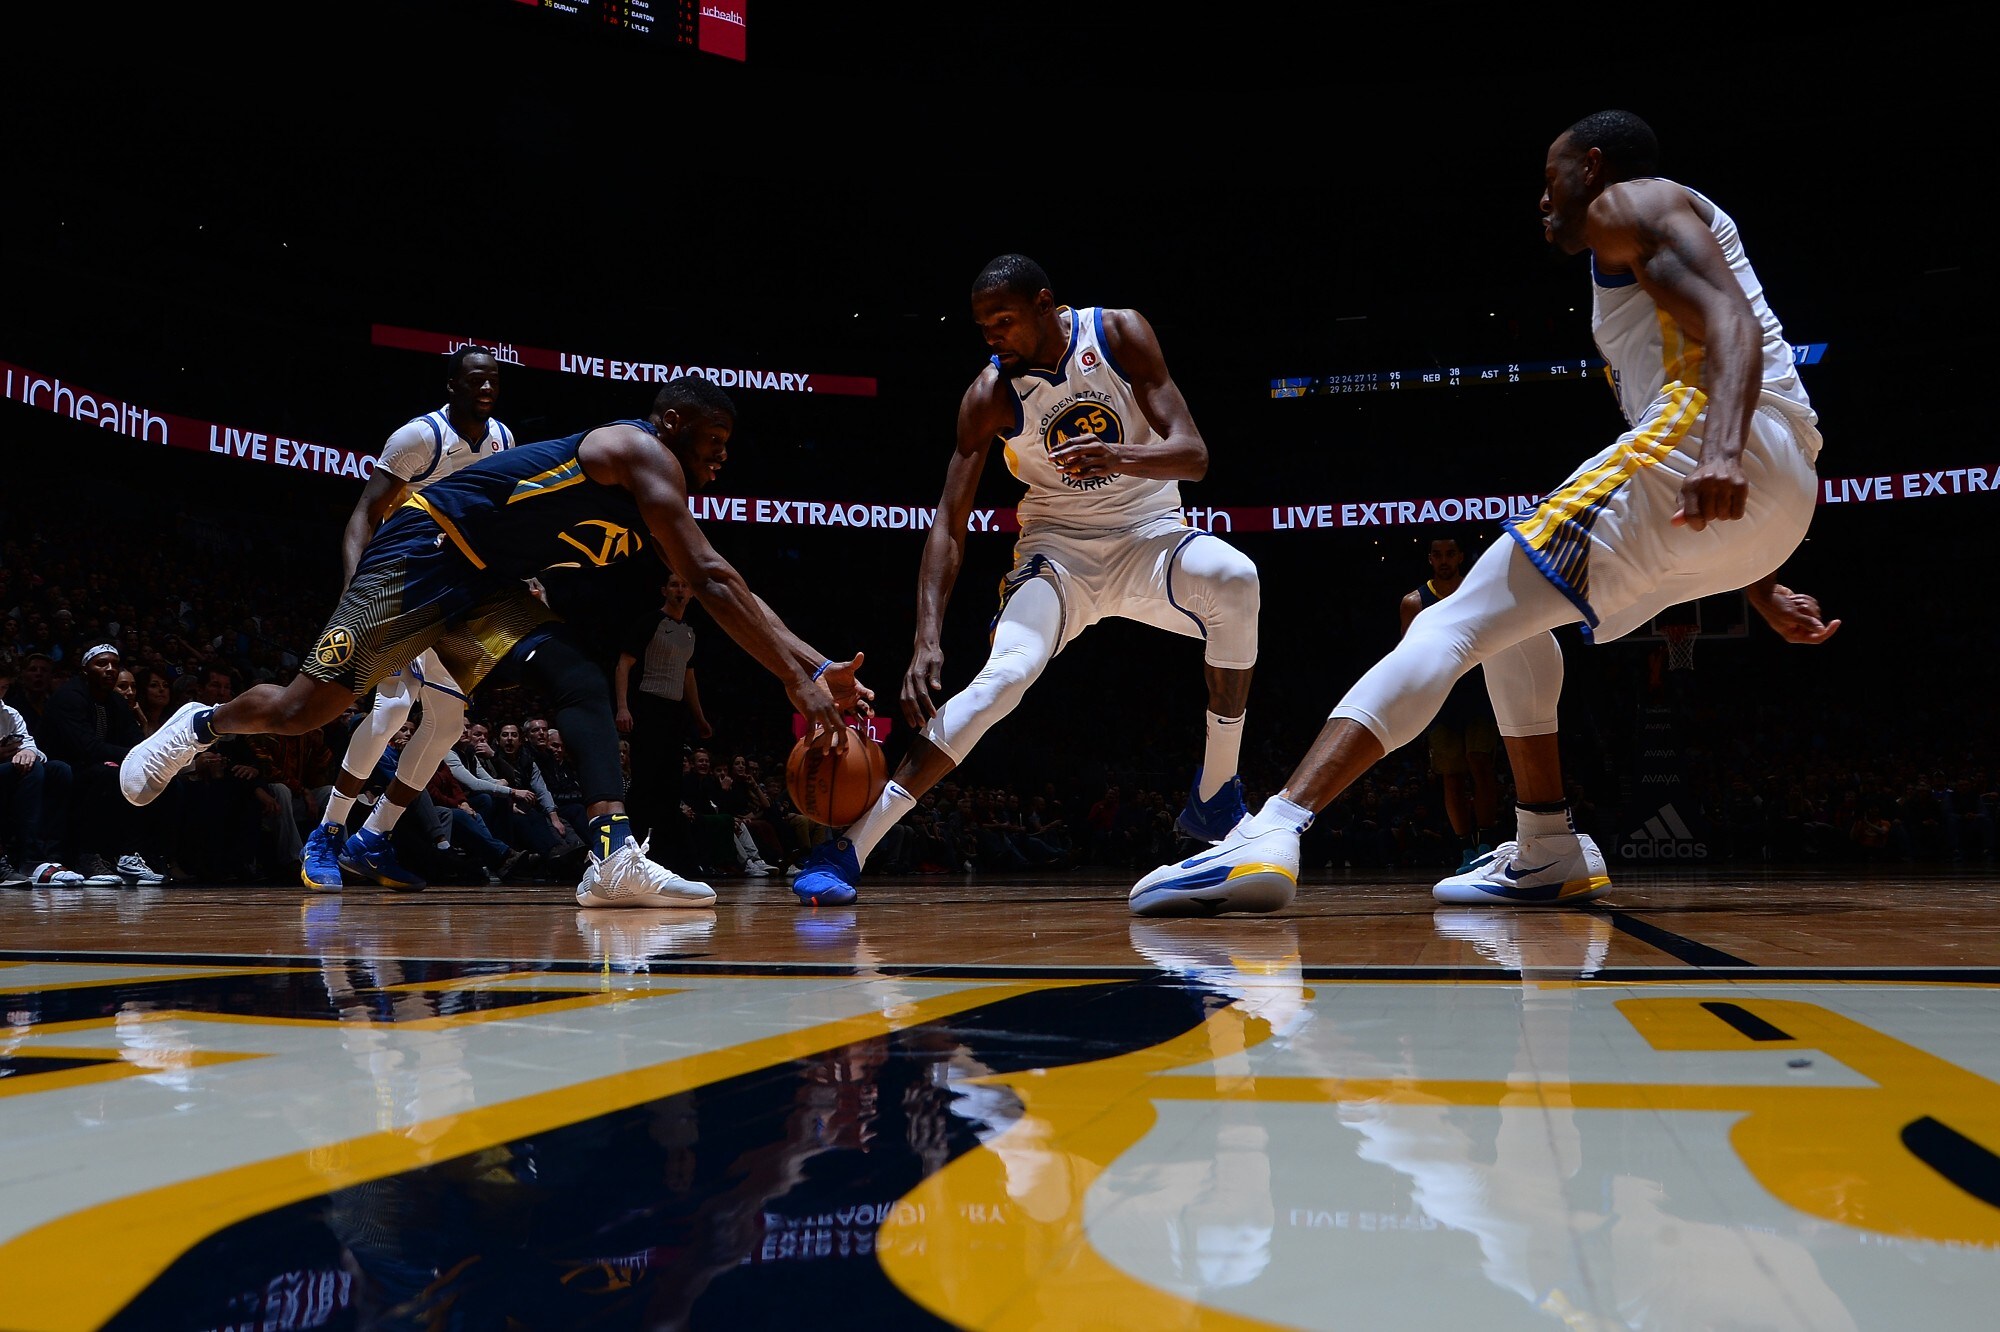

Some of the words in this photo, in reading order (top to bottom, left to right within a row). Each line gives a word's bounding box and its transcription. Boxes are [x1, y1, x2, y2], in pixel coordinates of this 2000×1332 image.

[553, 2, 578, 14] DURANT
[623, 8, 629, 16] 5
[631, 11, 655, 22] BARTON
[702, 6, 743, 25] uchealth
[623, 20, 629, 28] 7
[631, 23, 650, 33] LYLES
[1508, 364, 1519, 373] 24
[1550, 365, 1568, 375] STL
[1580, 360, 1587, 368] 8
[560, 352, 605, 378] LIVE
[610, 360, 813, 393] EXTRAORDINARY.
[1329, 376, 1340, 384] 32
[1342, 375, 1352, 384] 24
[1354, 374, 1364, 383] 27
[1367, 373, 1377, 382] 12
[1389, 371, 1401, 380] 95
[1422, 374, 1441, 383] REB
[1449, 368, 1460, 376] 38
[1480, 369, 1499, 379] AST
[1508, 374, 1520, 383] 26
[1580, 369, 1587, 378] 6
[1330, 385, 1340, 394] 29
[1342, 385, 1352, 393] 26
[1355, 384, 1365, 392] 22
[1367, 383, 1378, 391] 14
[1390, 381, 1400, 390] 91
[1449, 377, 1460, 386] 41
[1039, 396, 1074, 436] GOLDEN
[1074, 409, 1108, 434] 35
[209, 424, 268, 462] LIVE
[274, 437, 379, 481] EXTRAO
[1824, 476, 1894, 504] LIVE
[688, 496, 748, 522] LIVE
[1272, 504, 1334, 530] LIVE
[1342, 495, 1539, 527] EXTRAORDIN
[1644, 723, 1672, 732] AVAYA
[1644, 748, 1676, 759] AVAYA
[1641, 773, 1681, 786] AVAYA
[1620, 836, 1709, 860] adidas
